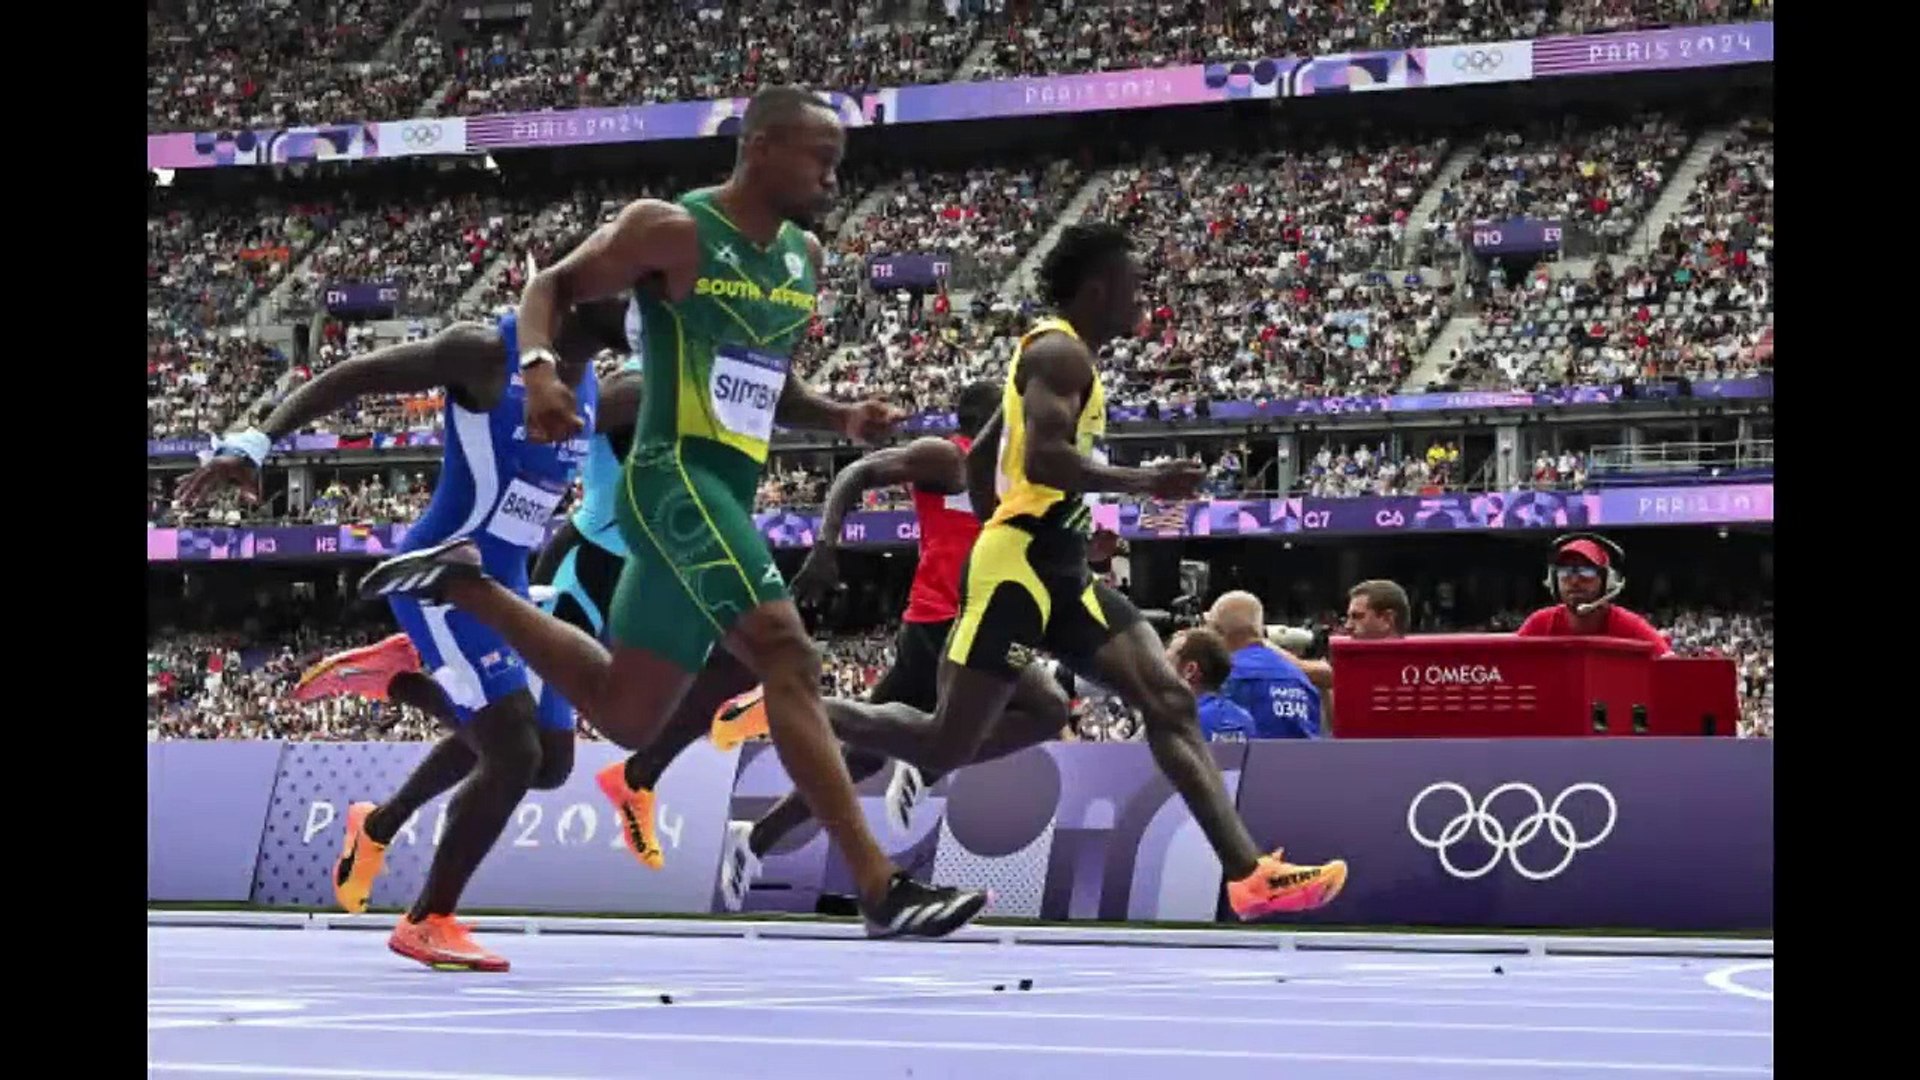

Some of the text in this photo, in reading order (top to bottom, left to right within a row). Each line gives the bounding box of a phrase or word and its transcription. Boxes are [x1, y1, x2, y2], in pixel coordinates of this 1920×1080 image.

[1589, 33, 1751, 64] PARIS 2024
[1025, 83, 1094, 105] PARIS
[512, 112, 645, 140] PARIS 2024
[694, 277, 761, 302] SOUTH
[1304, 508, 1331, 528] C7
[1425, 664, 1504, 685] OMEGA
